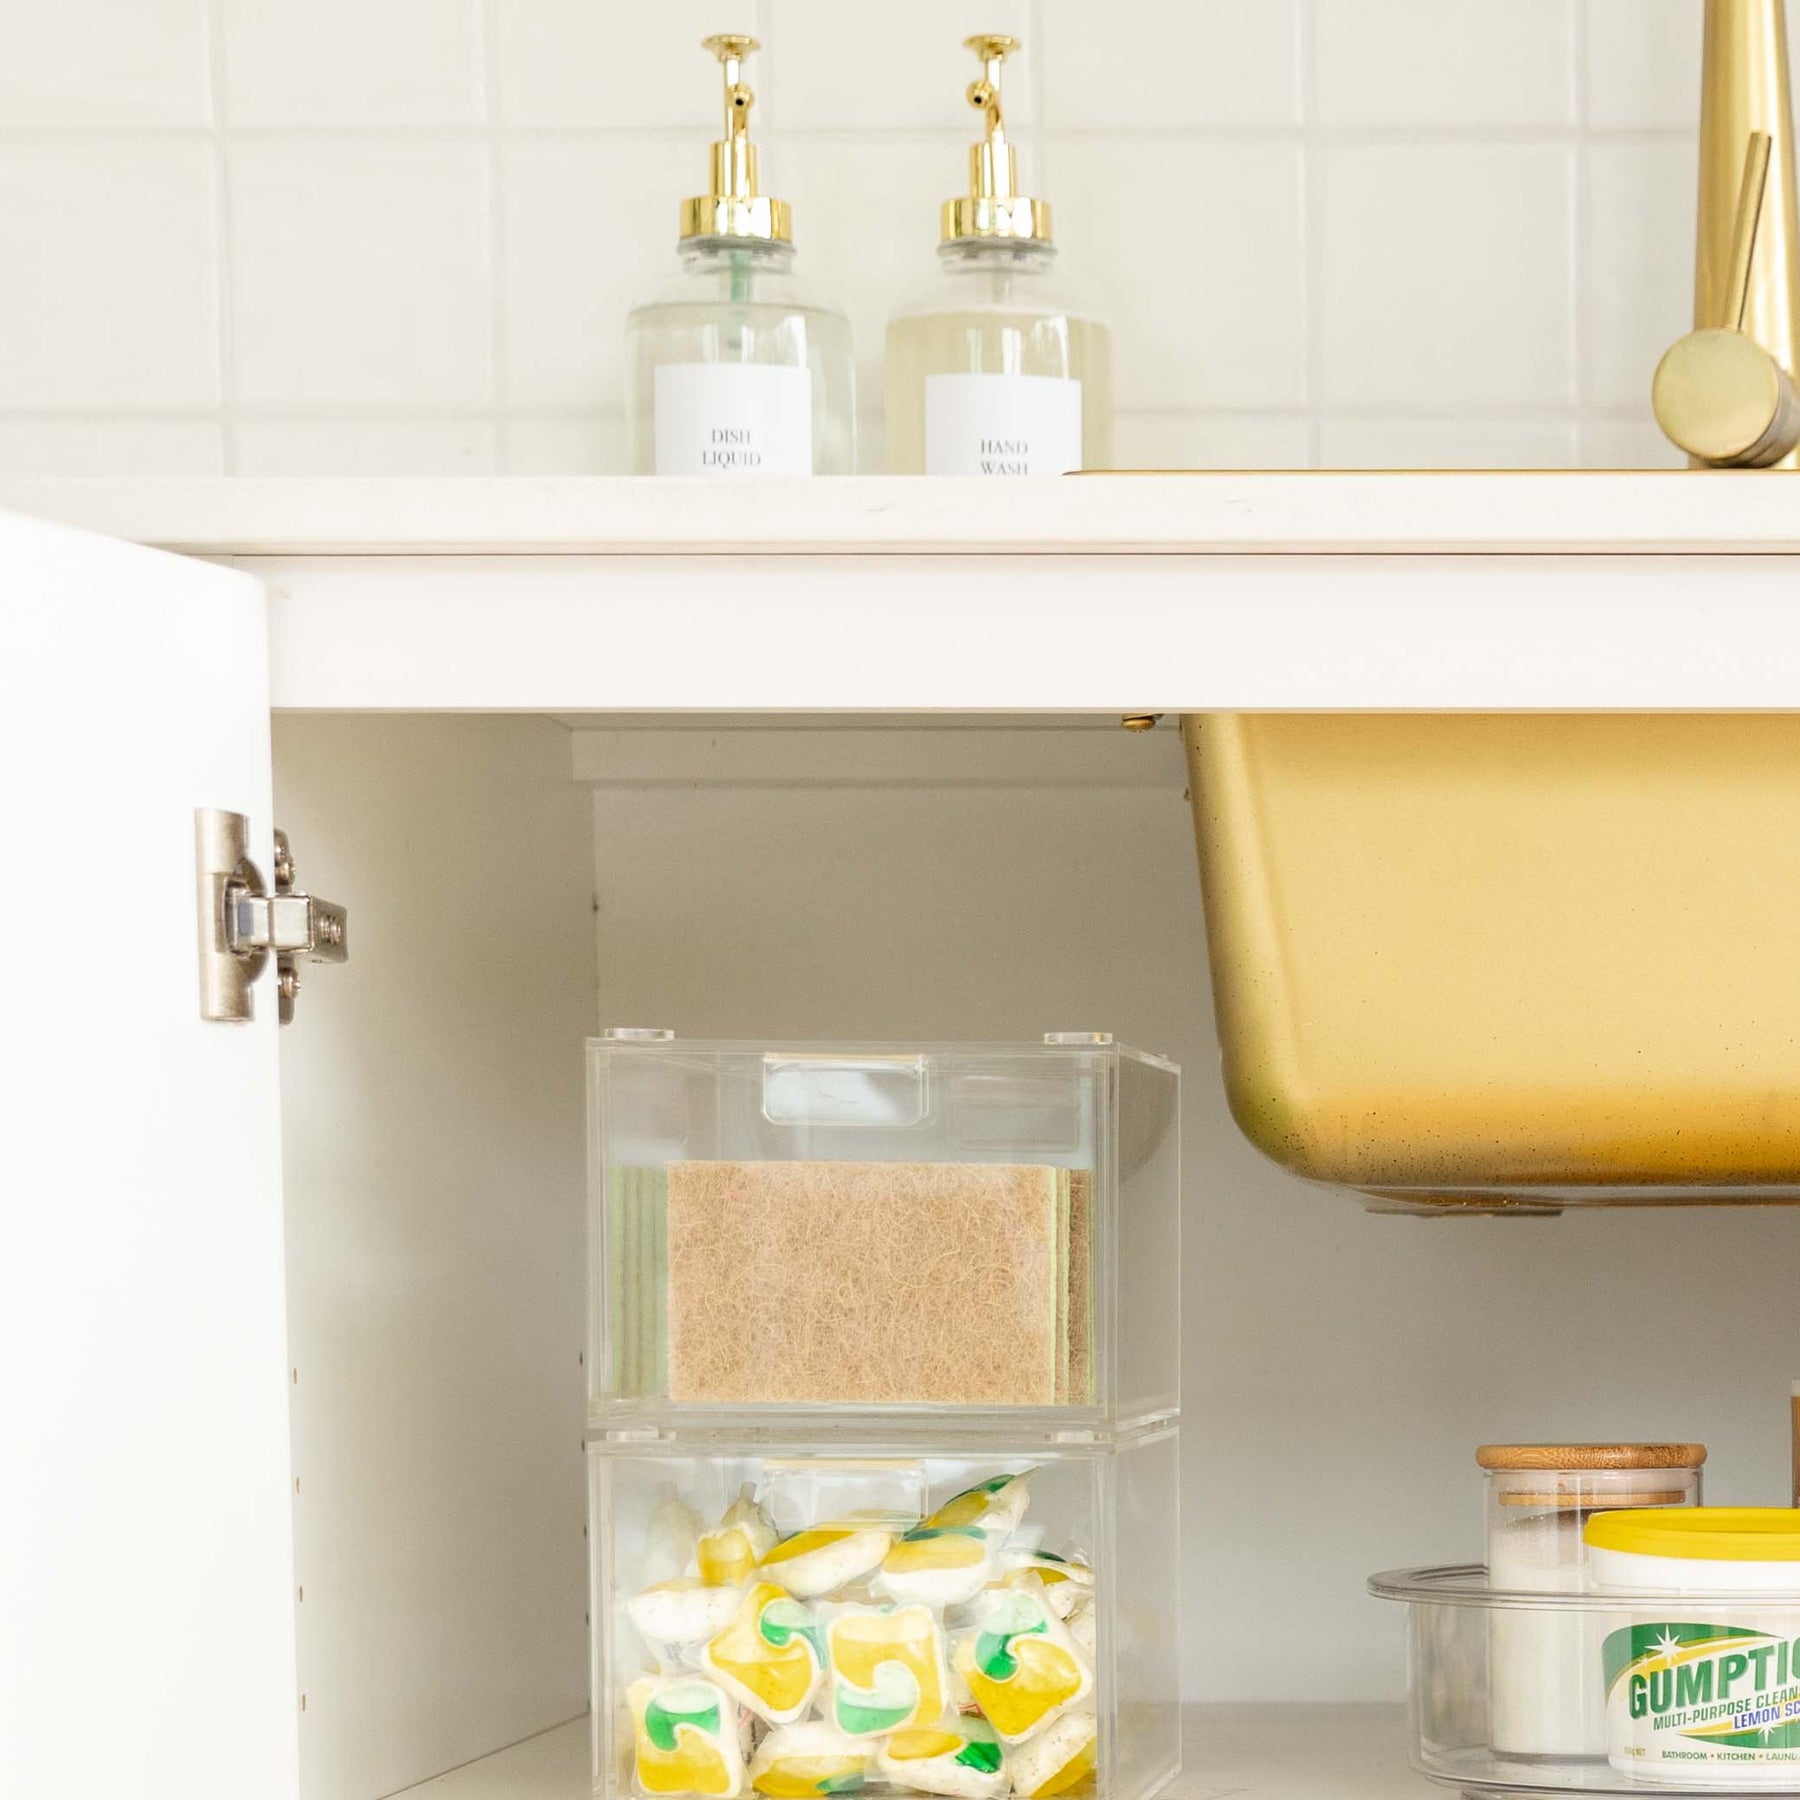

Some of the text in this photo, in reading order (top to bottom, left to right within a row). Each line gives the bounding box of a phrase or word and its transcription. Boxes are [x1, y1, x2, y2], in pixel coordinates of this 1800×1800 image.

[711, 429, 751, 444] DISH
[980, 440, 1028, 454] HAND
[702, 450, 761, 467] LIQUID
[980, 461, 1028, 476] WASH
[1653, 1697, 1751, 1731] MULTI-PURPOSE
[1734, 1706, 1781, 1730] LEMON
[1662, 1751, 1707, 1761] BATHROOM
[1717, 1752, 1755, 1761] KITCHEN
